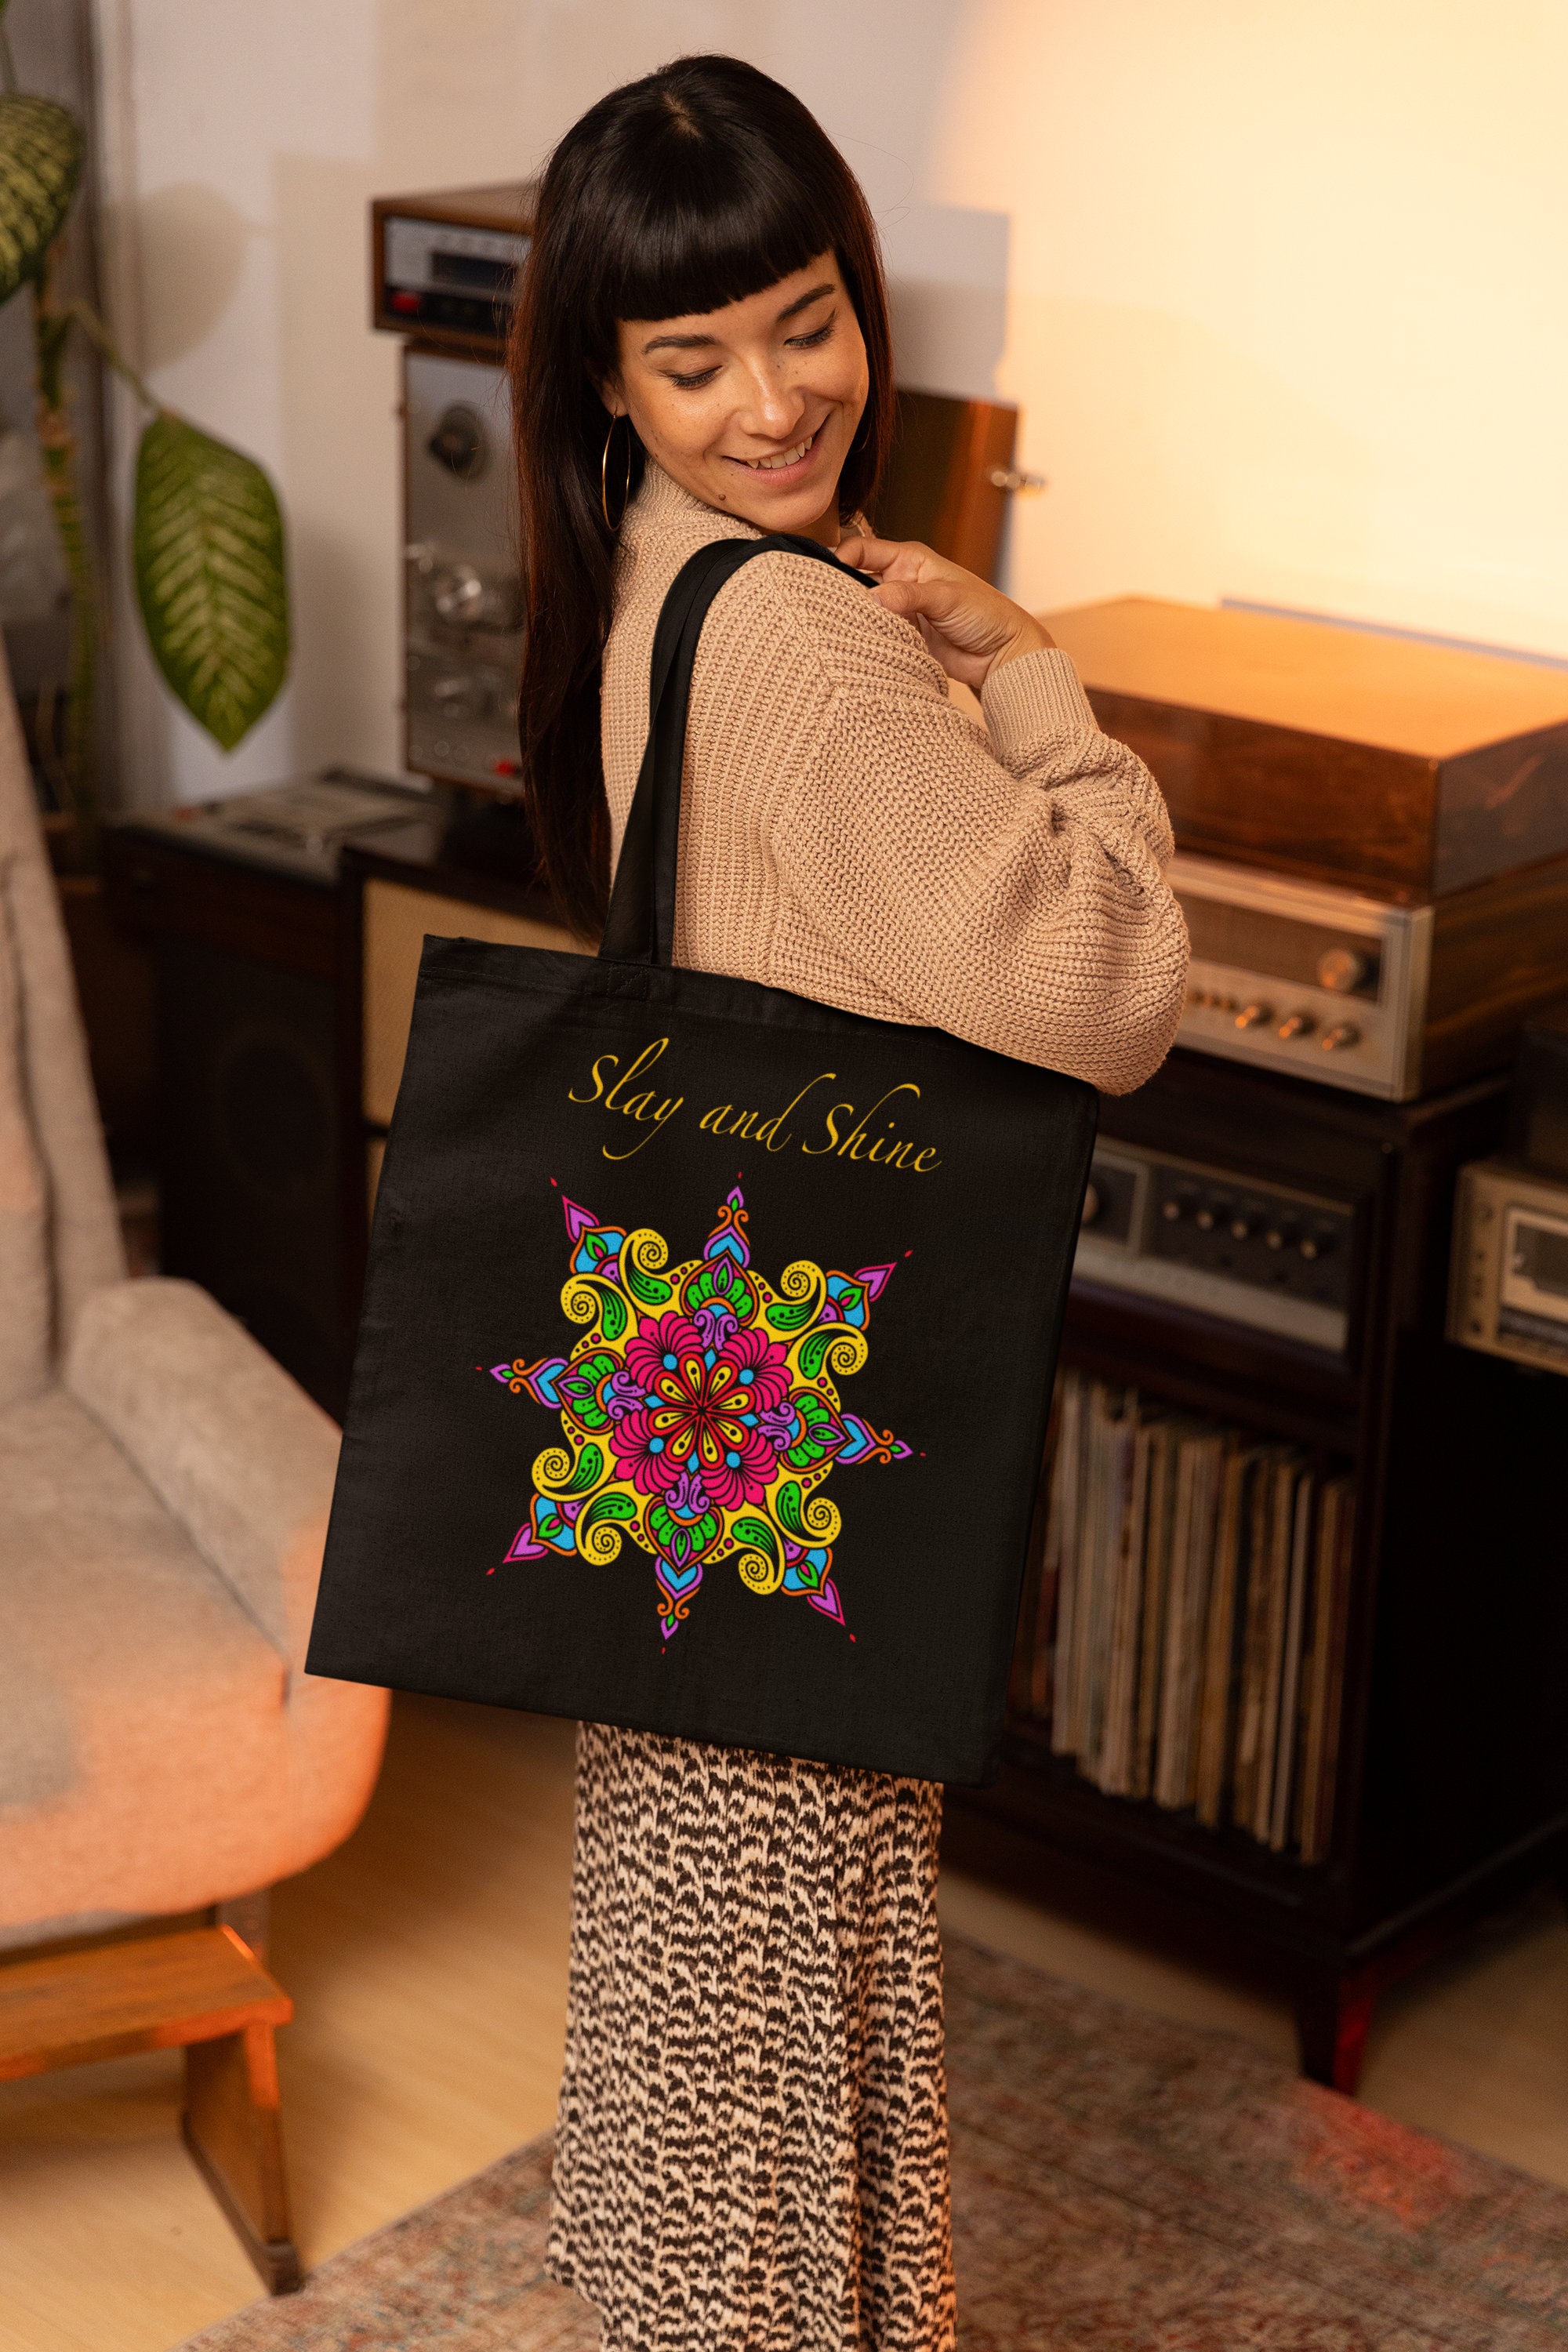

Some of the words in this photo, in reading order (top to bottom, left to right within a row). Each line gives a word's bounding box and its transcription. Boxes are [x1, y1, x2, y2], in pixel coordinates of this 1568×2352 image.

[568, 1037, 684, 1160] Slay
[699, 1073, 837, 1152] and
[801, 1083, 942, 1172] Shine
